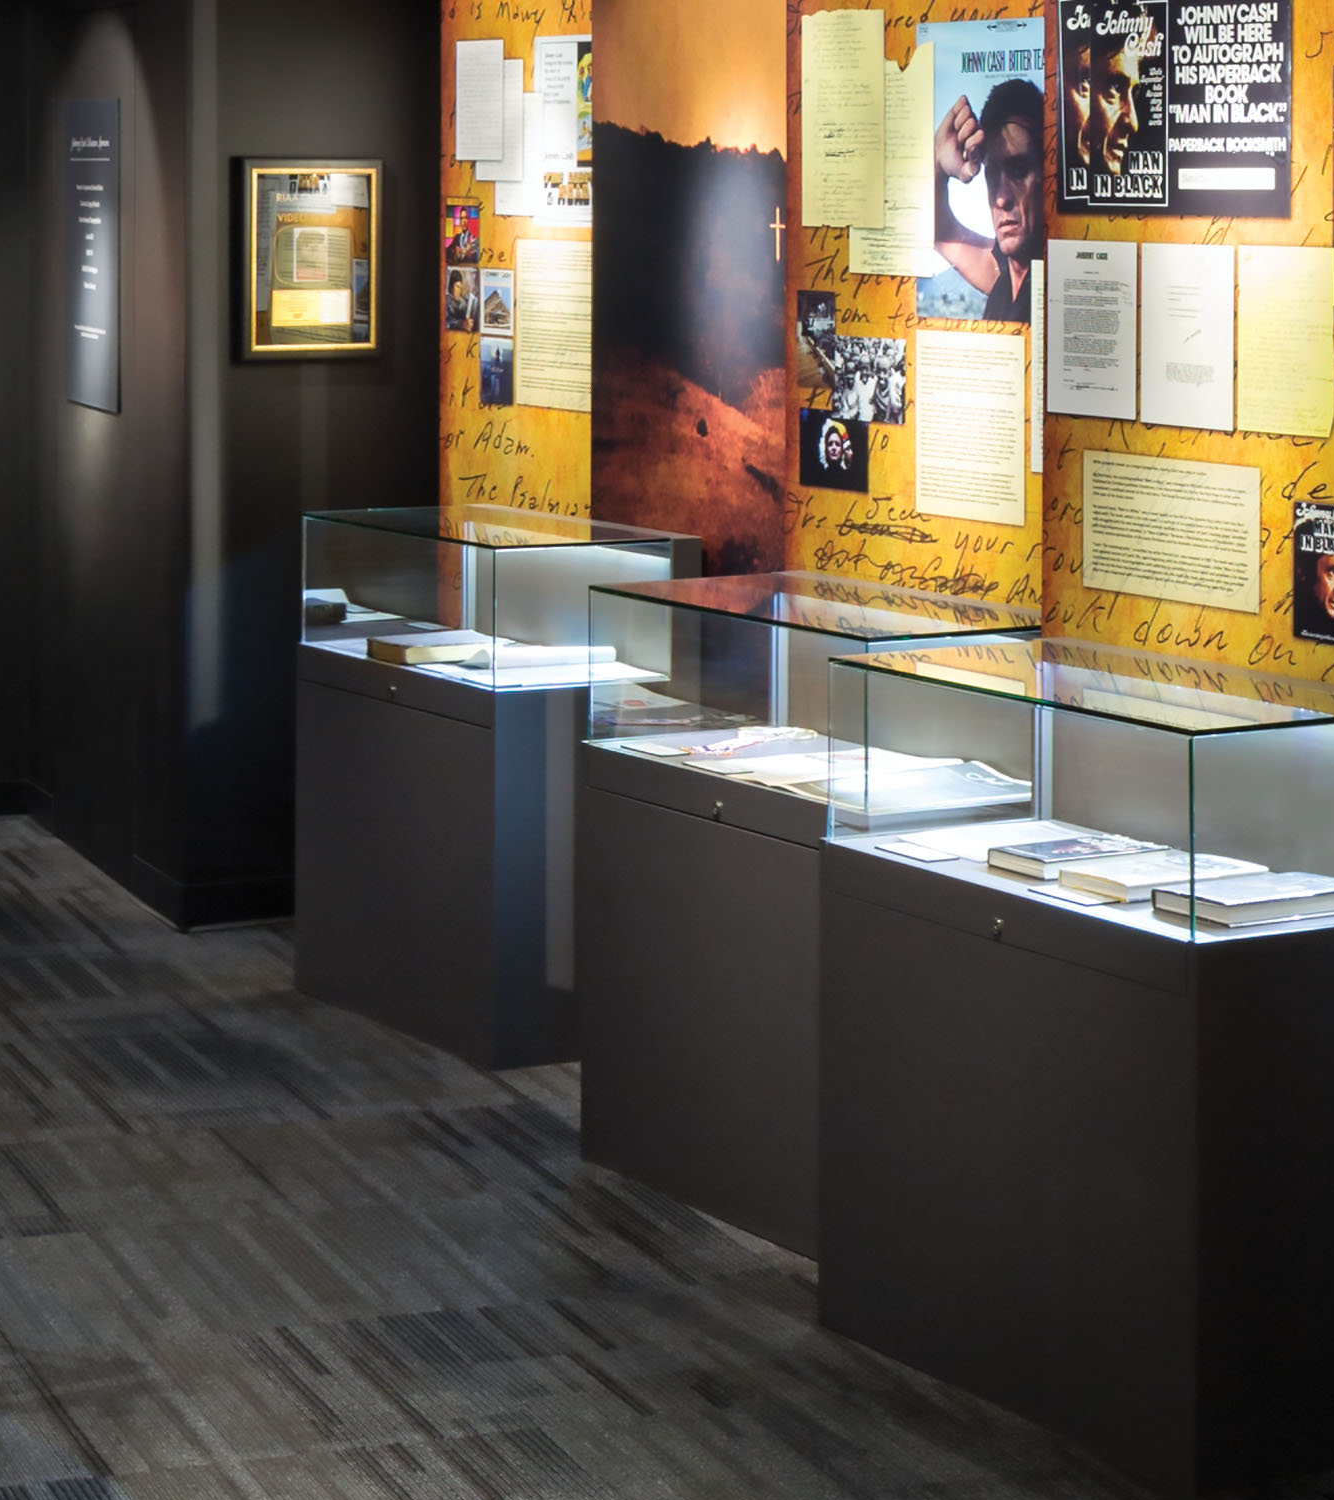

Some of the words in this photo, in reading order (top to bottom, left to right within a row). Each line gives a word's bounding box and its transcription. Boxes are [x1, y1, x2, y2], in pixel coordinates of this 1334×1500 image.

[1095, 9, 1155, 42] Johnny
[1176, 4, 1238, 26] JOHNNY
[1236, 2, 1279, 24] CASH
[1184, 25, 1217, 45] WILL
[1217, 24, 1235, 44] BE
[1236, 22, 1273, 43] HERE
[1123, 32, 1165, 60] Cash
[1171, 44, 1192, 65] TO
[1192, 42, 1284, 65] AUTOGRAPH
[961, 50, 987, 73] JOHNNY
[987, 49, 1006, 73] CASH
[1008, 48, 1032, 72] BITTER
[1174, 65, 1198, 85] HIS
[1198, 62, 1283, 84] PAPERBACK
[1204, 83, 1250, 104] BOOK
[1212, 103, 1230, 124] IN
[1168, 137, 1226, 153] PAPERBACK
[1128, 150, 1164, 175] MAN
[1069, 167, 1087, 191] IN
[1093, 173, 1112, 198] IN
[1113, 173, 1164, 199] BLACK
